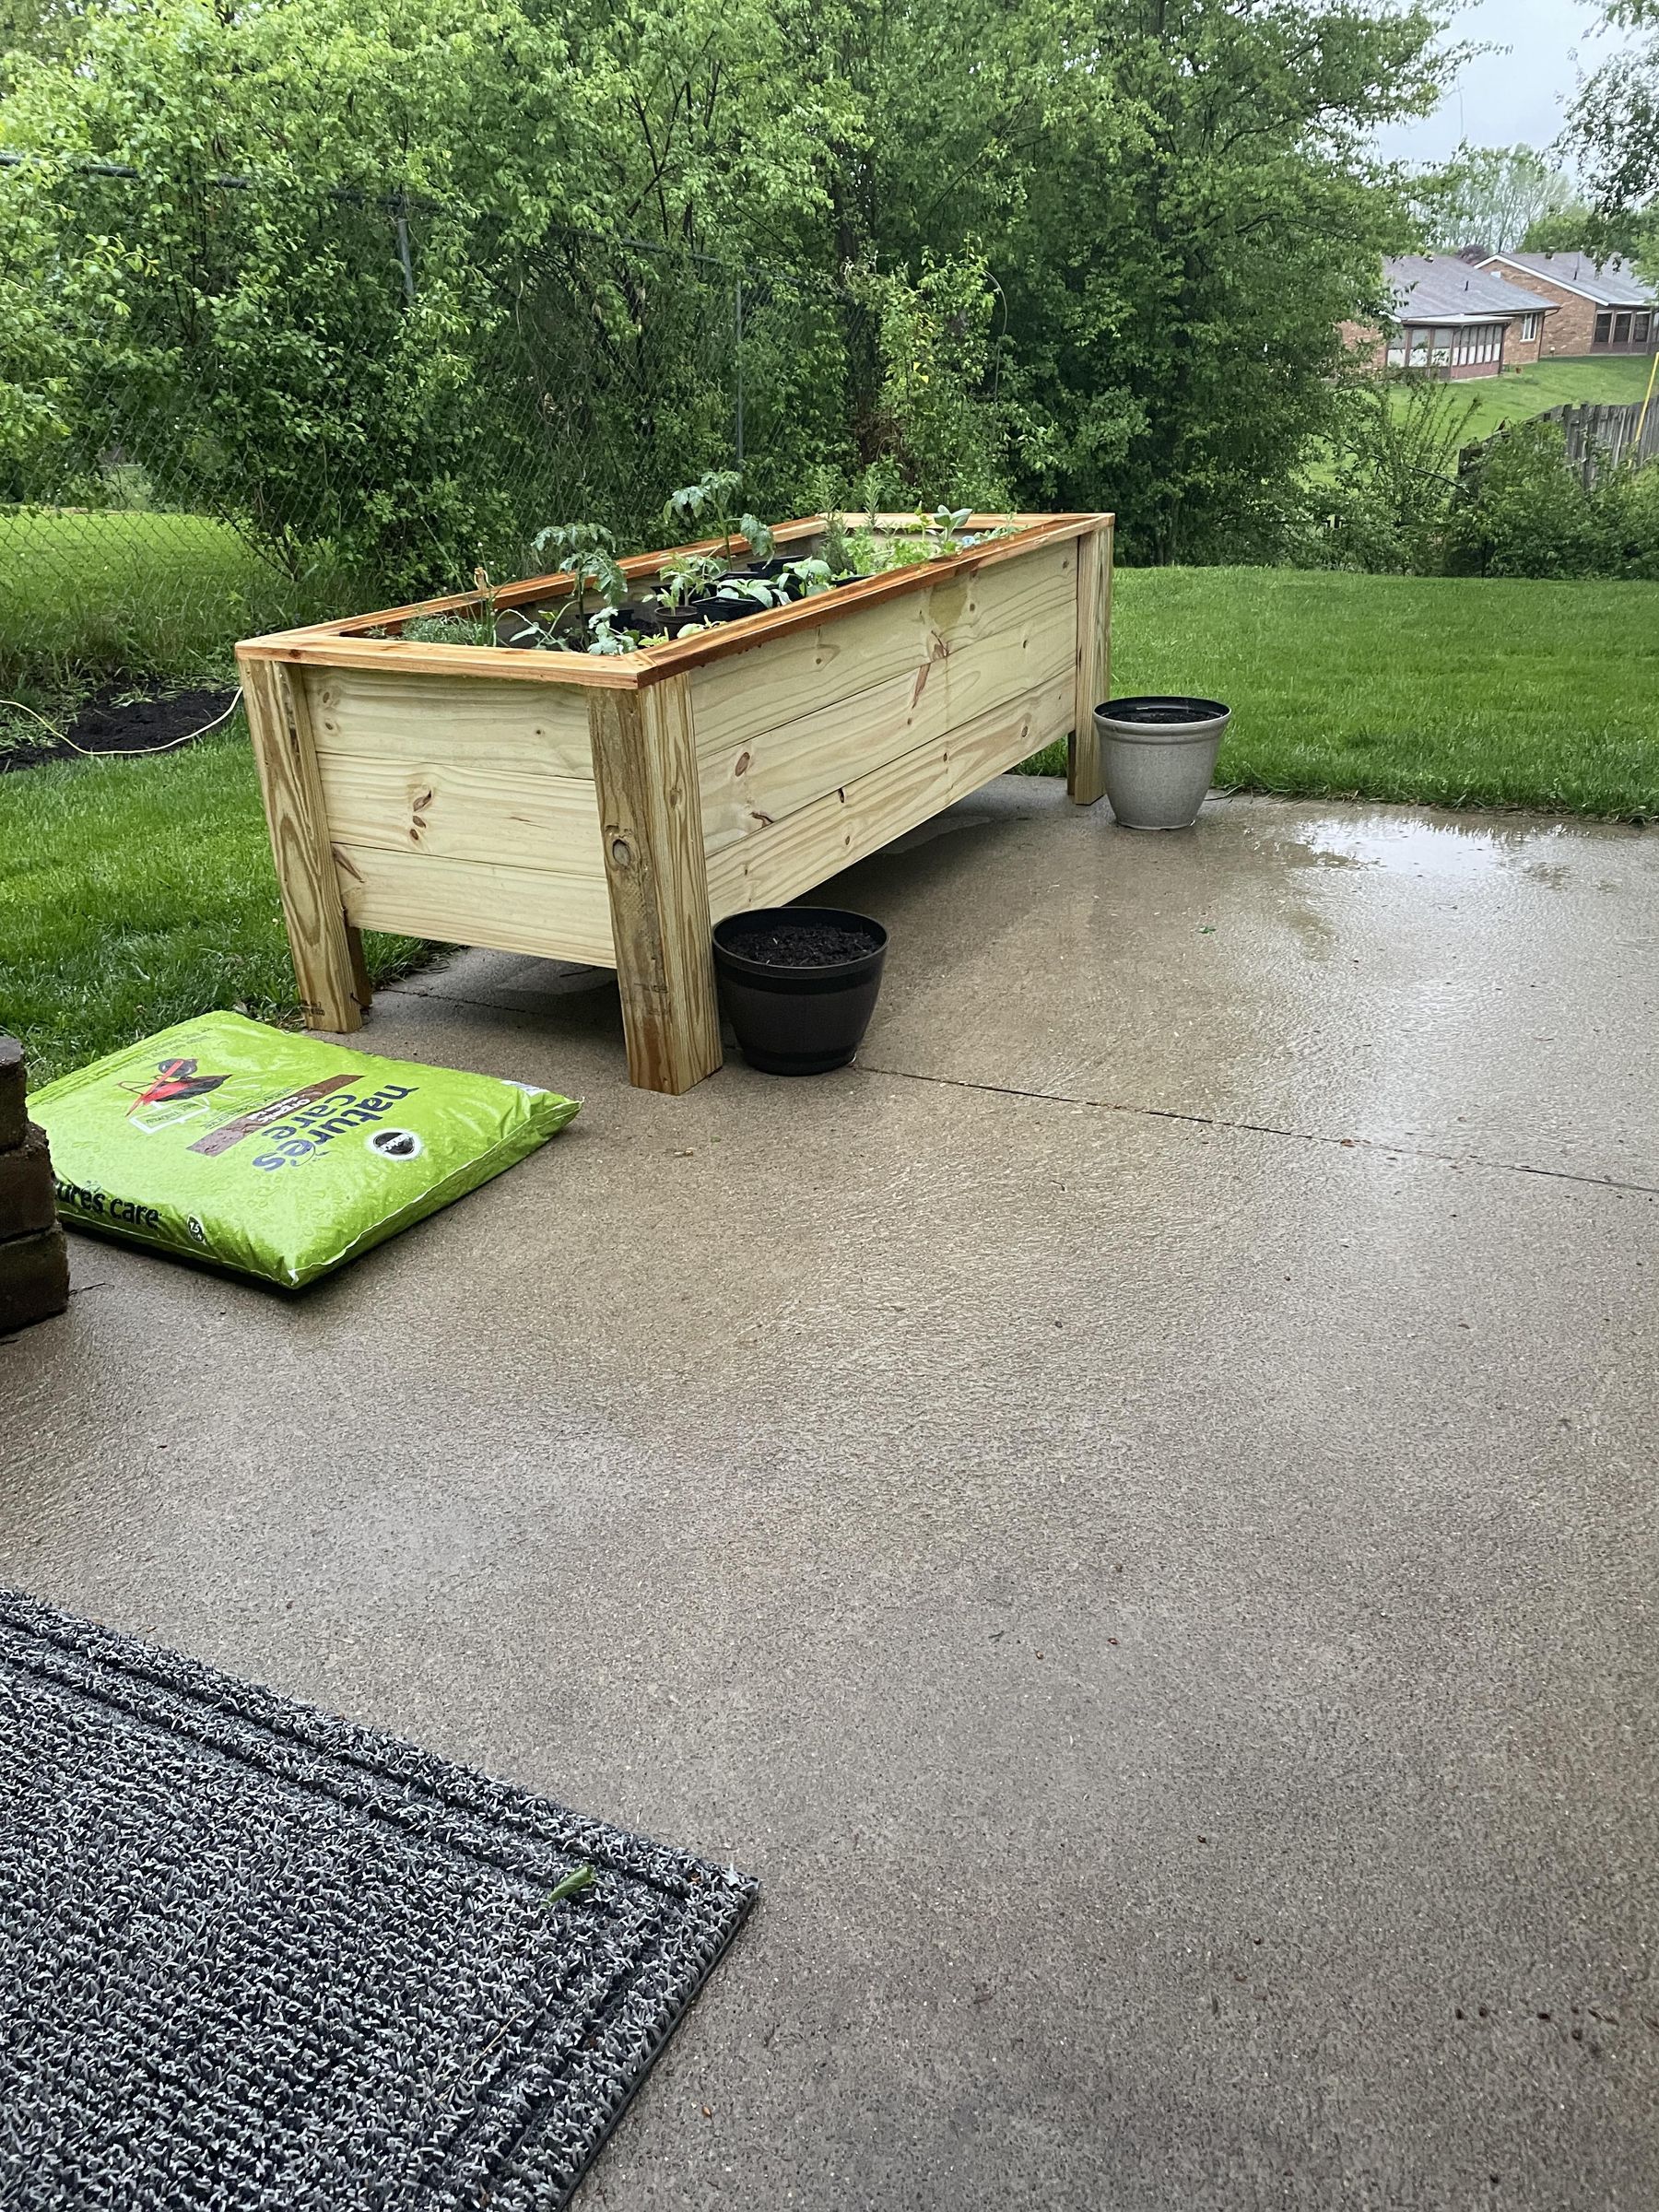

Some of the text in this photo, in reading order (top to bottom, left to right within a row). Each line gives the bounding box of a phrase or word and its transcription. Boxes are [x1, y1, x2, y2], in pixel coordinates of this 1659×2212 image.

[262, 1094, 357, 1139] care
[53, 1179, 160, 1230] ures care
